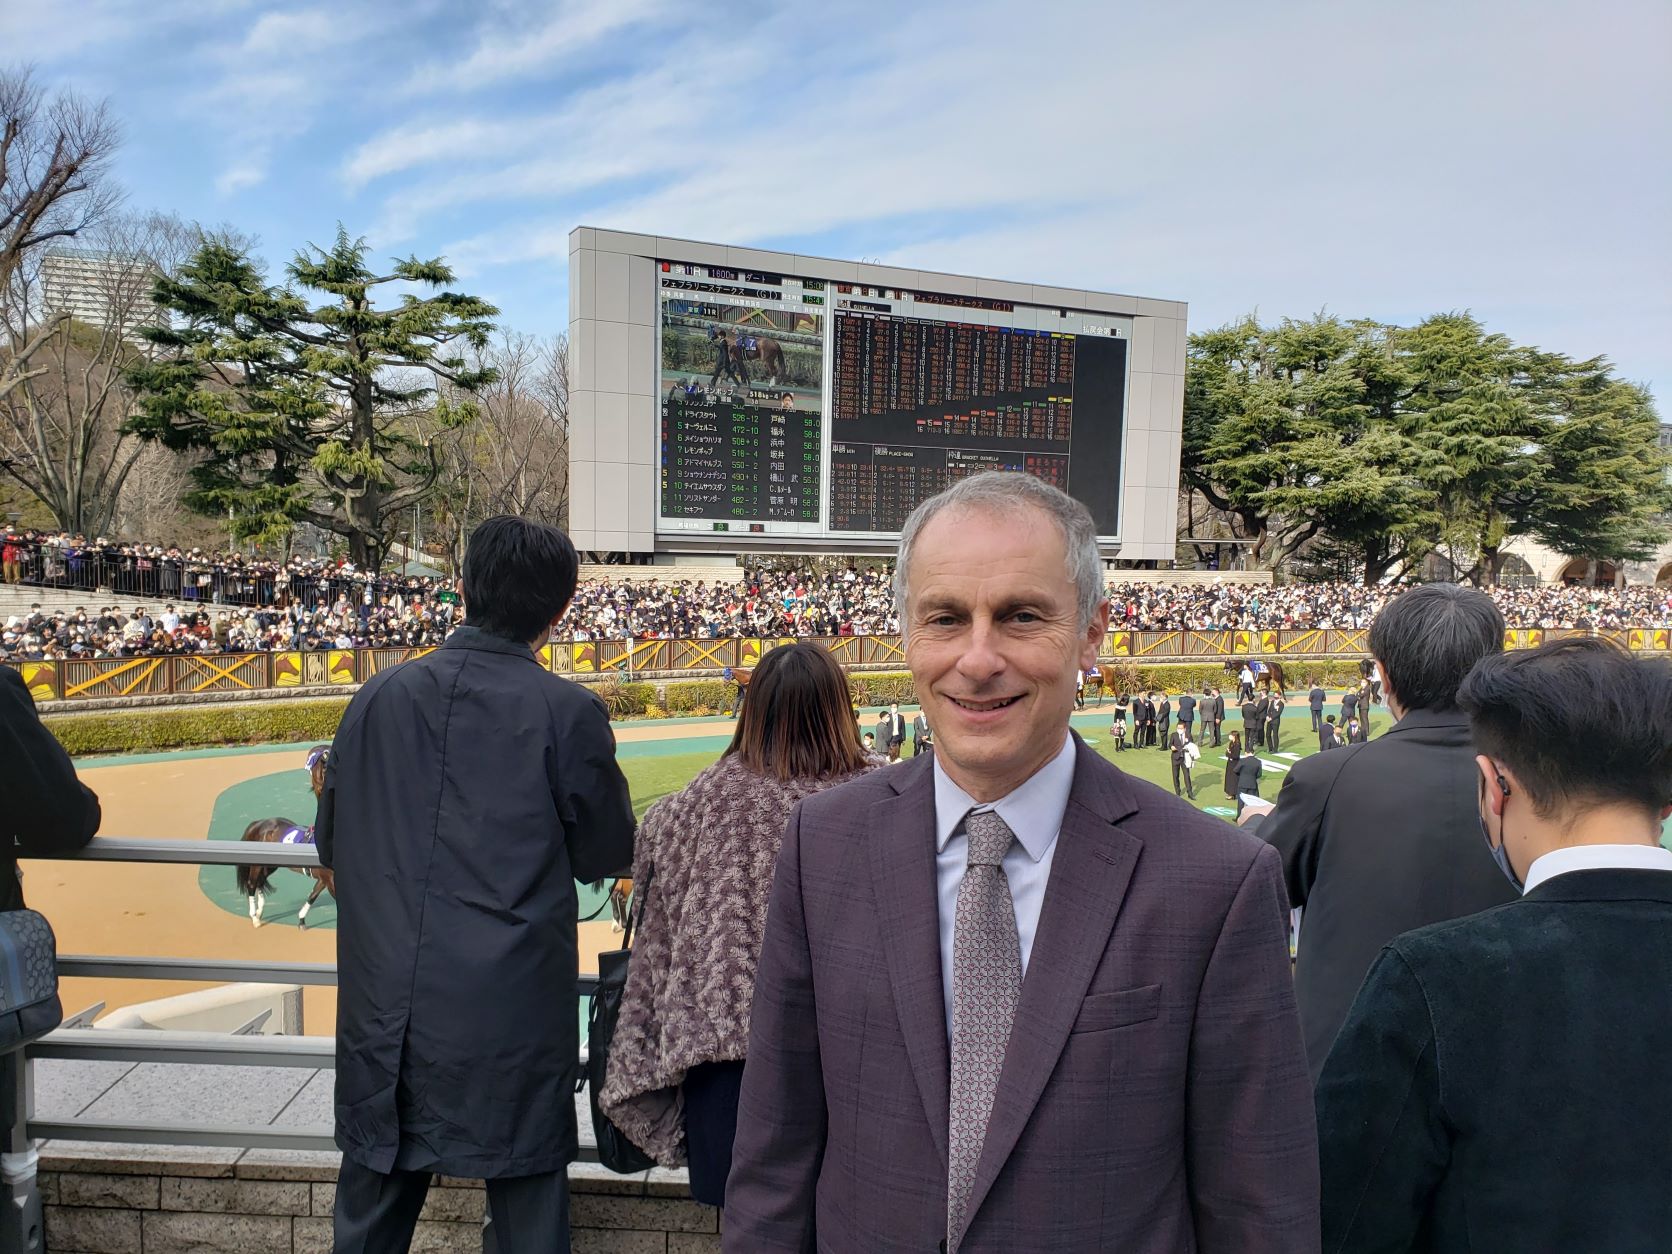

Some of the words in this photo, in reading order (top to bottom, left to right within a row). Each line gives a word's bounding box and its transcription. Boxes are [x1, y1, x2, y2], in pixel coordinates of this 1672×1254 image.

[746, 273, 765, 283] ダート
[663, 280, 745, 295] フェブラリーステークス
[915, 294, 983, 309] フェブラリーステークス
[704, 308, 717, 316] 11R
[697, 386, 733, 396] レモンポップ
[685, 411, 717, 420] ドライスタウト
[684, 422, 718, 432] オーヴェルニュ
[684, 436, 722, 444] メイショウハリオ
[684, 447, 713, 455] レモンポップ
[684, 459, 723, 468] アドマイヤルプス
[684, 471, 727, 480] ショウナンナデシコ
[674, 482, 683, 490] 10
[684, 483, 727, 492] テイエムサウスダン
[684, 495, 721, 503] ソリストサンダー
